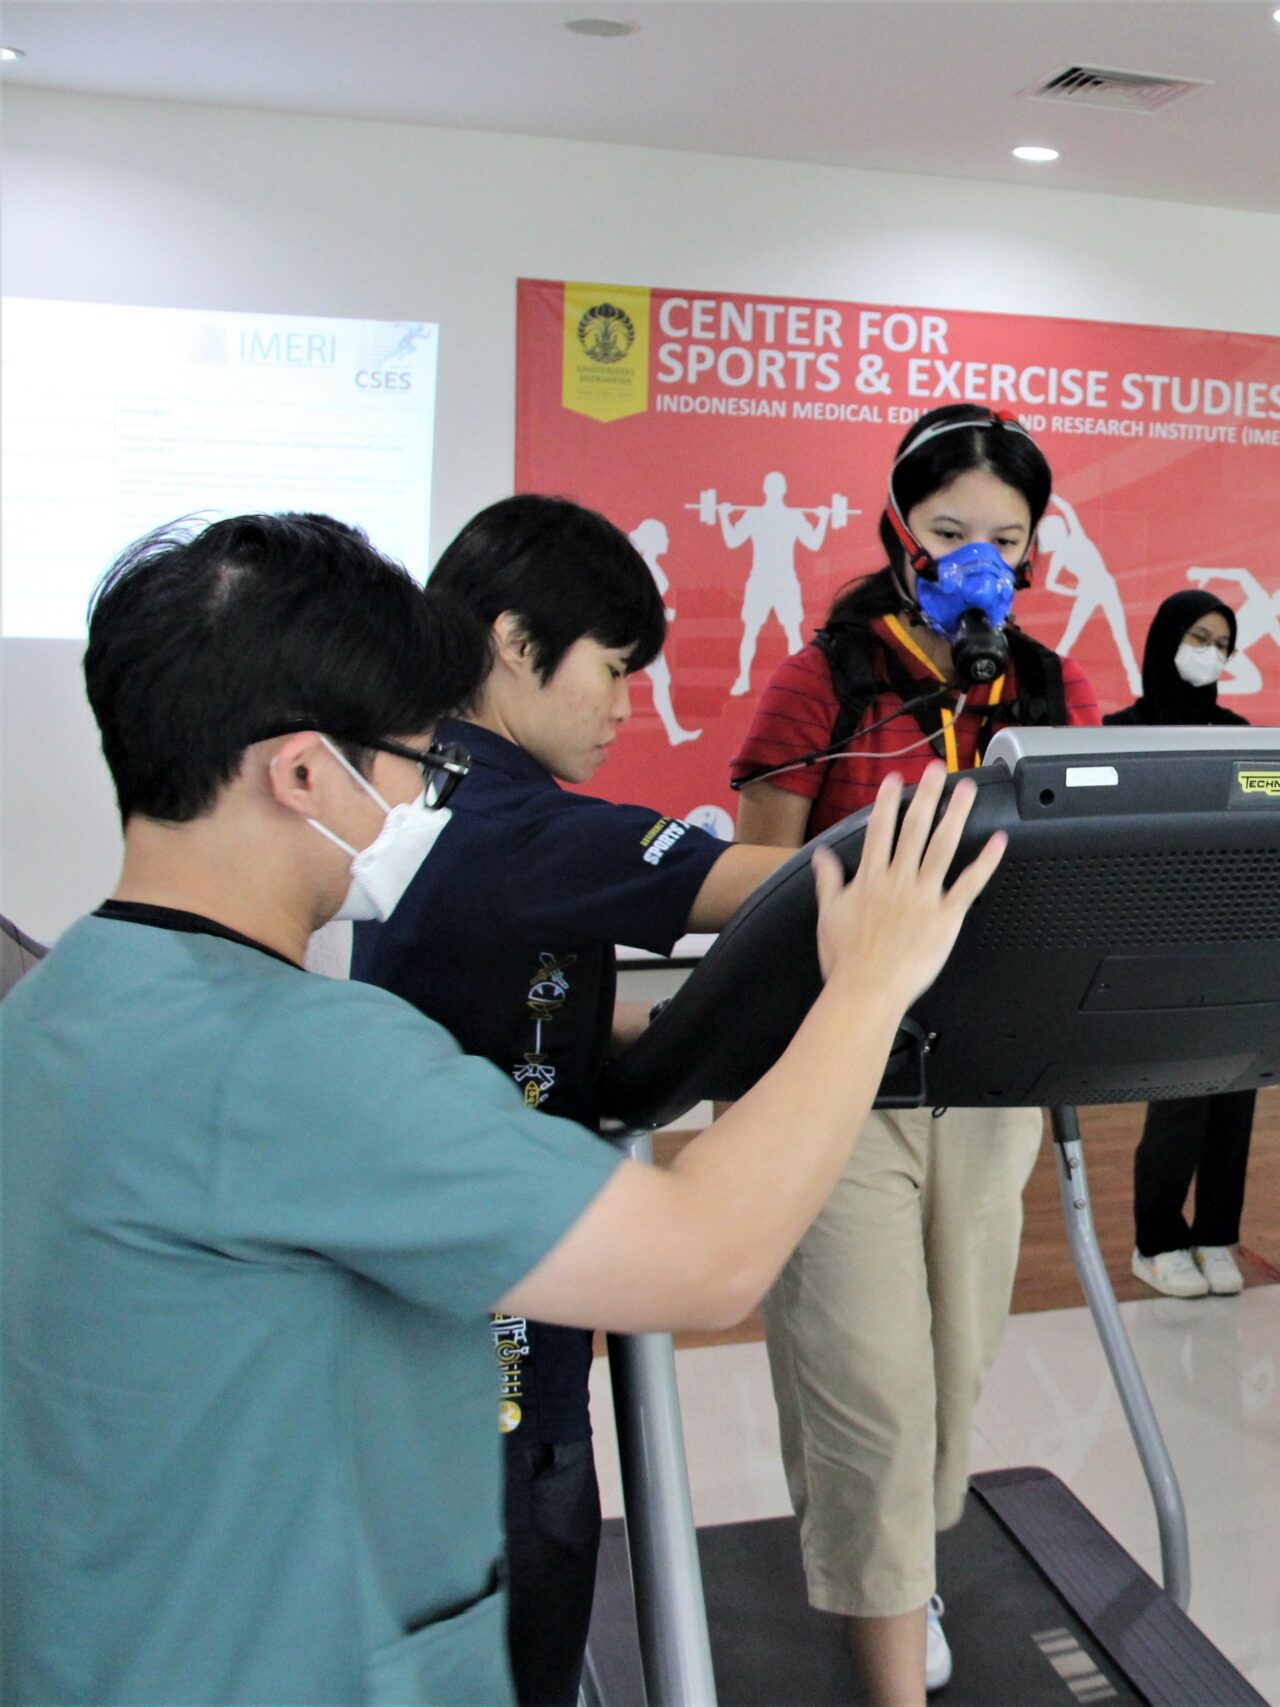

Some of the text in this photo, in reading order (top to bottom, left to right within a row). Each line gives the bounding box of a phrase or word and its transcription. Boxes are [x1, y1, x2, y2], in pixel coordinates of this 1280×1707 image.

[239, 330, 337, 364] IMERI
[658, 298, 949, 355] CENTER FOR
[355, 369, 412, 391] CSES
[656, 343, 841, 393] SPORTS
[854, 354, 892, 396] &
[907, 358, 1109, 409] EXERCISE
[655, 393, 787, 418] INDONESIAN
[792, 400, 883, 423] MEDICAL
[1017, 413, 1047, 433] ND
[1051, 415, 1144, 438] RESEARCH
[1149, 421, 1237, 445] INSTITUTE
[643, 821, 686, 865] SPORTS
